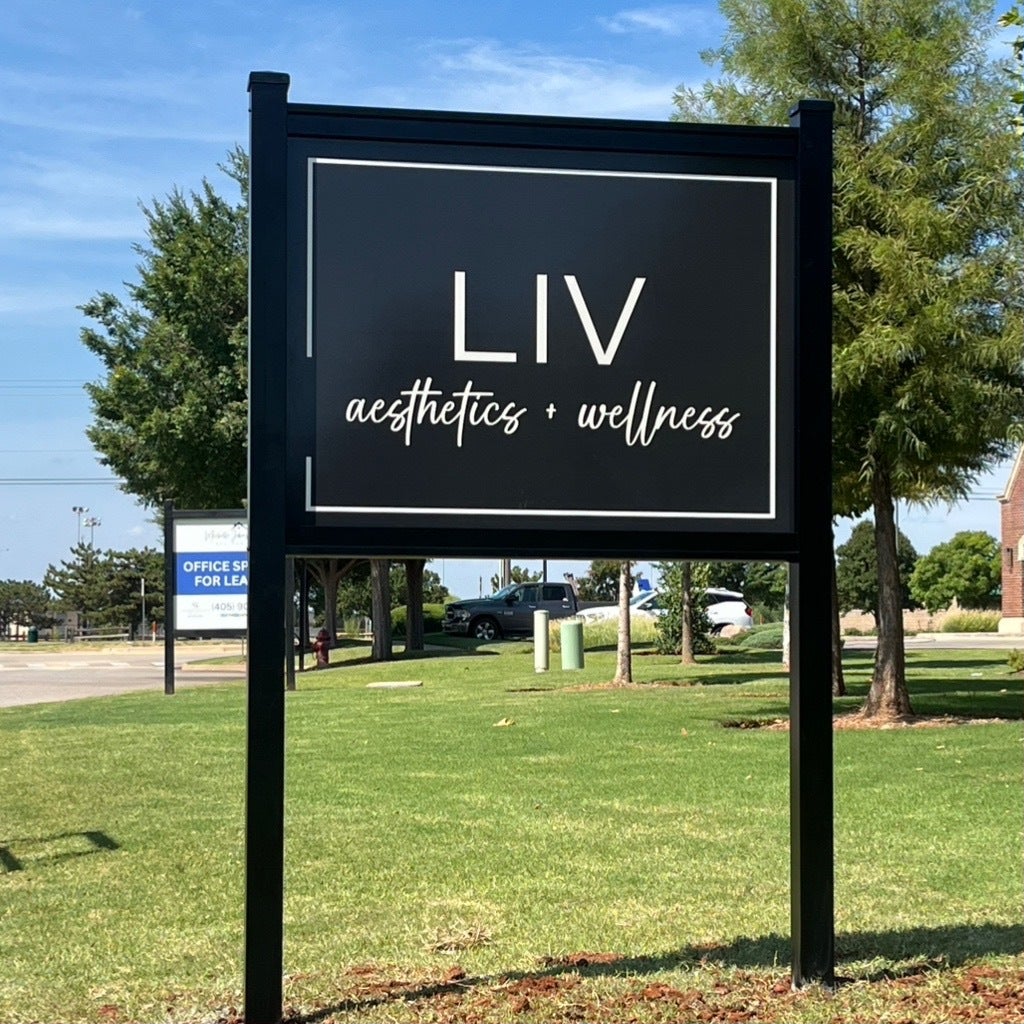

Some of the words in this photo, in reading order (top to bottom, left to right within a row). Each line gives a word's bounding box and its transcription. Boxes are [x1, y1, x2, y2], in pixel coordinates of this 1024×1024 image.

[454, 271, 646, 365] LIV
[346, 377, 527, 447] aesthetics
[546, 403, 556, 419] +
[578, 381, 740, 446] wellness
[183, 561, 230, 572] OFFICE
[195, 576, 220, 587] FOR
[224, 575, 248, 587] LEA
